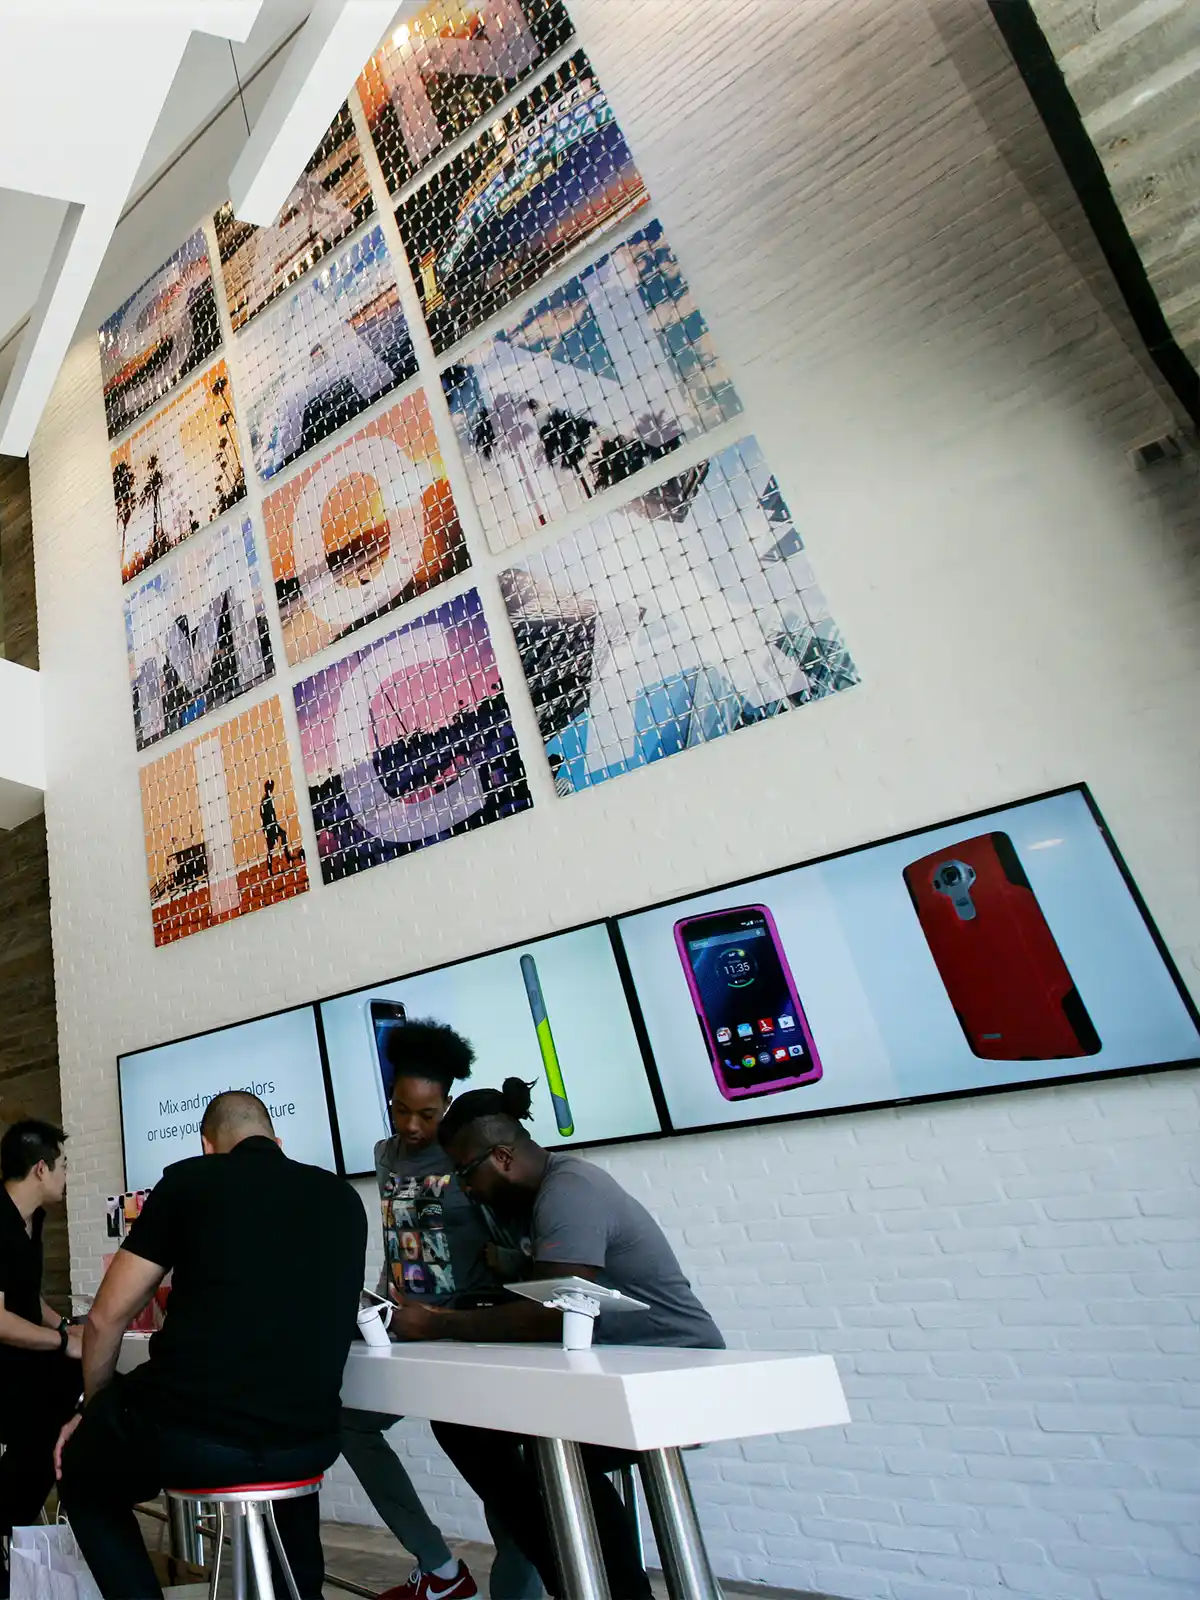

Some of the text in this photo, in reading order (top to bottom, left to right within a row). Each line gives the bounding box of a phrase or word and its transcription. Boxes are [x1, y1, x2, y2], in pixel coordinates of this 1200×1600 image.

[724, 962, 750, 975] 11:35
[159, 1099, 178, 1116] Mix
[181, 1094, 200, 1112] and
[147, 1129, 157, 1142] or
[160, 1126, 178, 1139] use
